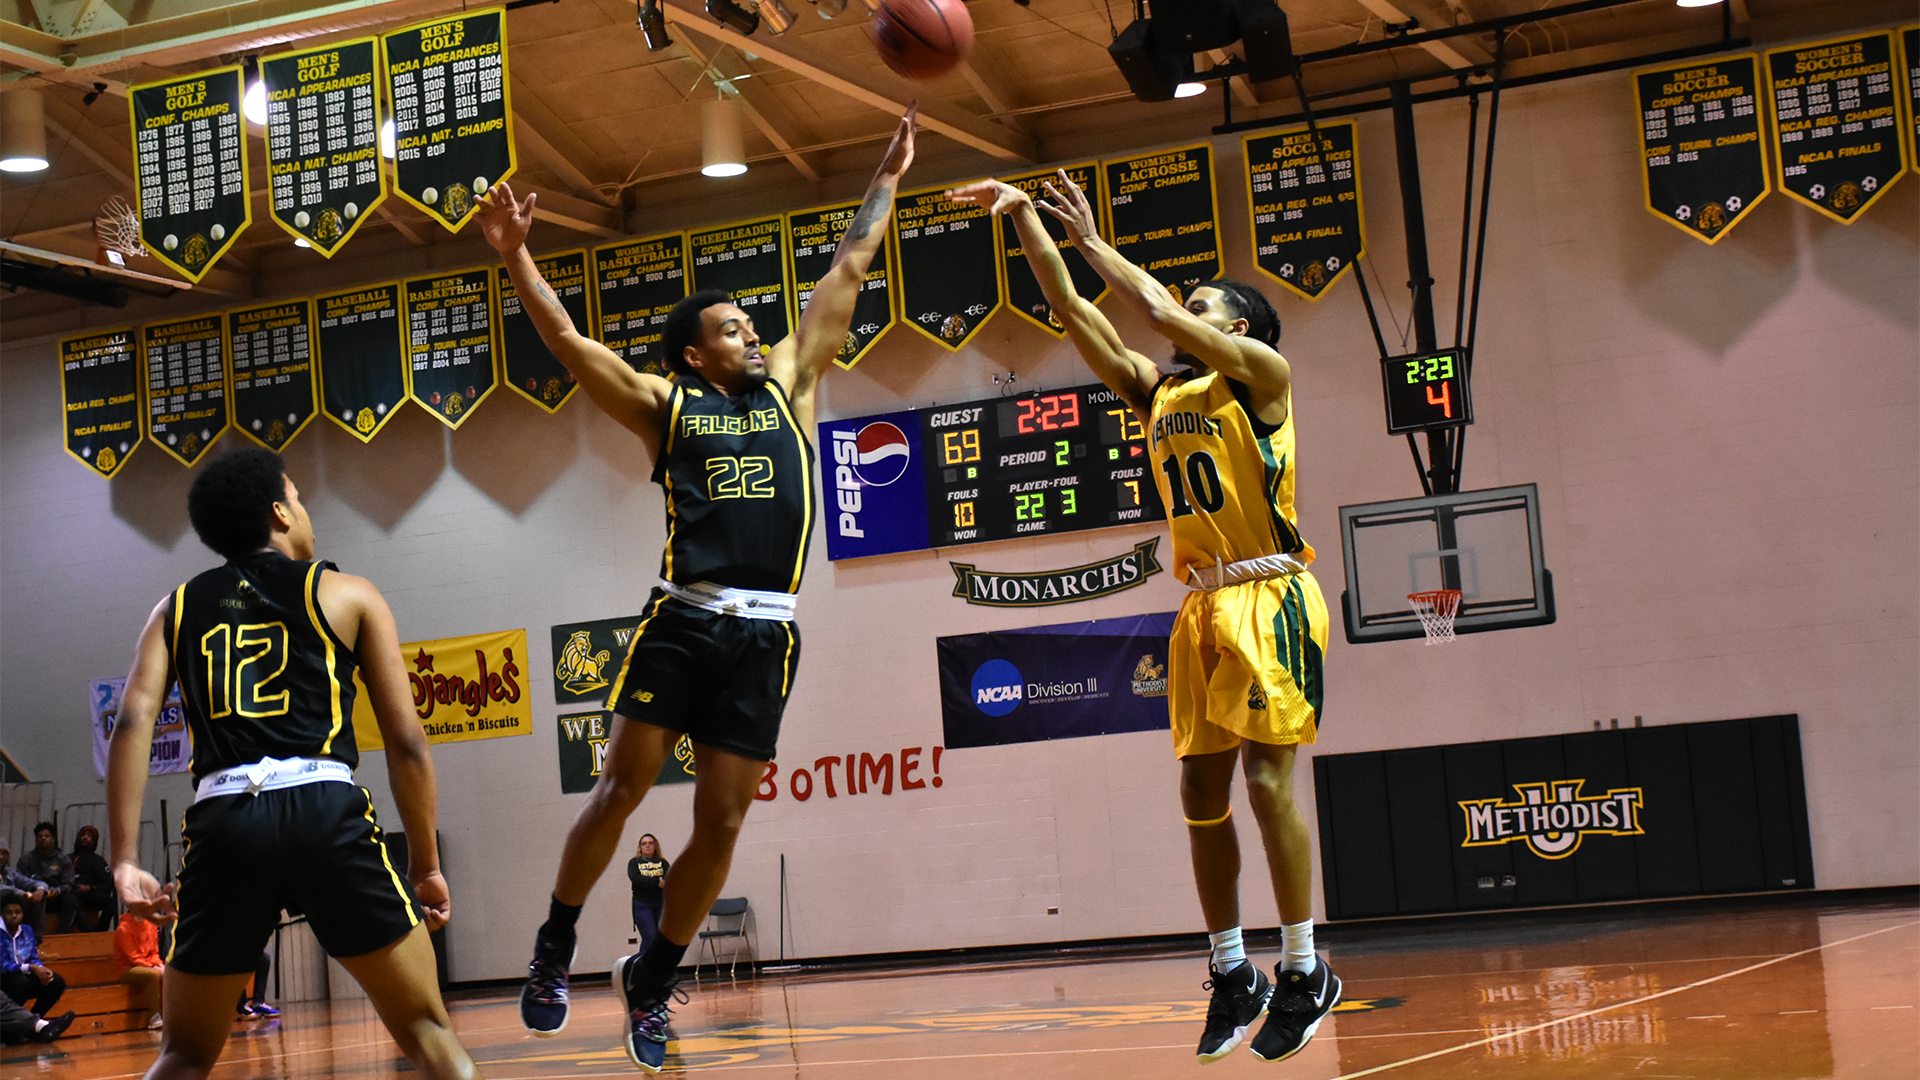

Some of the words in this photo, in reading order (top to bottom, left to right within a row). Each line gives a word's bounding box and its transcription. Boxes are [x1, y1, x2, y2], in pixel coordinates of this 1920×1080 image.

[420, 21, 464, 39] MEN'S
[421, 32, 465, 52] GOLF
[1796, 42, 1863, 61] WOMEN'S
[298, 52, 339, 69] MEN'S
[391, 60, 420, 75] NCAA
[423, 42, 499, 67] APPEARANCES
[1795, 52, 1865, 74] SOCCER
[298, 63, 340, 82] GOLF
[394, 73, 414, 86] 2001
[422, 66, 445, 80] 2002
[453, 59, 476, 73] 2003
[479, 54, 502, 68] 2004
[1674, 67, 1717, 81] MEN'S
[1775, 76, 1806, 90] NCAA
[1809, 62, 1889, 84] APPEARANCES
[166, 81, 206, 98] MEN'S
[268, 88, 296, 101] NCAA
[300, 72, 372, 96] APPEARANCES
[1663, 75, 1730, 95] SOCCER
[166, 92, 207, 110] GOLF
[298, 96, 317, 108] 1982
[1652, 95, 1688, 109] CONF.
[1691, 86, 1744, 102] CHAMPS
[146, 114, 178, 129] CONF.
[182, 103, 229, 121] CHAMPS
[326, 102, 346, 115] 1987
[354, 109, 373, 121] 1992
[165, 124, 185, 136] 1977
[219, 113, 237, 126] 1982
[397, 119, 419, 132] 2017
[1780, 119, 1812, 133] NCAA
[1815, 115, 1841, 127] REG.
[1844, 106, 1893, 123] CHAMPS
[219, 125, 238, 137] 1987
[299, 131, 319, 144] 1994
[397, 135, 427, 149] NCAA
[431, 129, 454, 143] NAT.
[457, 118, 504, 137] CHAMPS
[271, 148, 292, 160] 1997
[353, 132, 375, 146] 2000
[1646, 145, 1674, 157] CONF.
[1679, 139, 1713, 152] TOURN.
[1715, 132, 1757, 147] CHAMPS
[1798, 150, 1834, 164] NCAA
[1838, 142, 1882, 158] FINALS
[220, 149, 238, 161] 1997
[272, 162, 301, 174] NCAA
[304, 157, 328, 170] NAT.
[332, 147, 376, 165] CHAMPS
[398, 148, 420, 161] 2015
[1128, 152, 1186, 170] WOMEN'S
[1648, 156, 1671, 167] 2012
[193, 165, 214, 178] 2000
[220, 160, 239, 173] 2001
[300, 170, 319, 182] 1991
[328, 165, 349, 177] 1992
[355, 160, 375, 172] 1994
[1119, 160, 1198, 183] LACROSSE
[1251, 162, 1278, 174] NCAA
[168, 181, 190, 194] 2004
[329, 177, 349, 189] 1997
[1120, 181, 1151, 194] CONF.
[1154, 172, 1200, 188] CHAMPS
[142, 197, 163, 209] 2007
[222, 183, 242, 196] 2010
[301, 193, 322, 205] 2010
[143, 207, 163, 220] 2013
[194, 199, 214, 211] 2017
[819, 209, 855, 223] MEN'S
[898, 204, 934, 220] CROSS
[1255, 203, 1284, 214] NCAA
[1286, 199, 1309, 210] REG.
[899, 219, 924, 230] NCAA
[927, 208, 990, 226] APPEARANCES
[692, 222, 781, 247] CHEERLEADING
[793, 223, 828, 237] CROSS
[1116, 234, 1142, 245] CONF.
[1144, 228, 1174, 240] TOURN.
[1177, 221, 1213, 235] CHAMPS
[1271, 232, 1303, 244] NCAA
[1306, 226, 1343, 239] FINALS
[615, 242, 664, 257] WOMEN'S
[701, 244, 729, 256] CONF.
[732, 235, 773, 250] CHAMPS
[801, 235, 830, 247] CONF.
[599, 247, 682, 271] BASKETBALL
[1149, 251, 1216, 270] APPEARANCES
[606, 268, 634, 280] CONF.
[636, 260, 675, 275] CHAMPS
[409, 282, 487, 302] BASKETBALL
[432, 277, 463, 288] MEN'S
[736, 283, 781, 299] CHAMPIONS
[326, 289, 390, 309] BASEBALL
[354, 300, 391, 314] CHAMPS
[444, 294, 480, 307] CHAMPS
[239, 306, 300, 324] BASEBALL
[265, 317, 301, 329] CHAMPS
[154, 321, 214, 337] BASEBALL
[460, 335, 489, 347] CHAMPS
[1406, 356, 1454, 384] 2:23
[66, 401, 88, 412] NCAA
[109, 393, 135, 405] CHAMPS
[1426, 381, 1452, 418] 4
[681, 408, 780, 438] FALCONS
[931, 408, 982, 428] GUEST
[1017, 394, 1080, 434] 2:23
[74, 425, 97, 436] NCAA
[100, 420, 132, 432] FINALIST
[1107, 408, 1145, 441] 73
[944, 430, 981, 464] 69
[1000, 451, 1047, 467] PERIOD
[1055, 441, 1070, 466] 2
[1109, 448, 1119, 460] B
[706, 456, 775, 501] 22
[967, 467, 977, 479] B
[1111, 468, 1143, 480] FOULS
[833, 431, 864, 538] PEPSI
[1010, 477, 1079, 493] PLAYER-FOUL
[1124, 481, 1140, 506] 7
[1162, 450, 1224, 520] 10
[947, 489, 979, 501] FOULS
[1015, 493, 1045, 520] 22
[1061, 489, 1077, 515] 3
[955, 502, 975, 528] 10
[1118, 509, 1142, 520] WON
[954, 530, 978, 541] WON
[1017, 521, 1046, 533] GAME
[972, 554, 1138, 601] MONARCHS
[201, 621, 290, 720] 12
[977, 685, 1022, 704] NCAA
[1027, 681, 1083, 699] Division
[1087, 678, 1098, 692] III
[478, 715, 519, 733] Biscuits
[562, 715, 606, 740] WE
[1469, 794, 1637, 840] METHODIST
